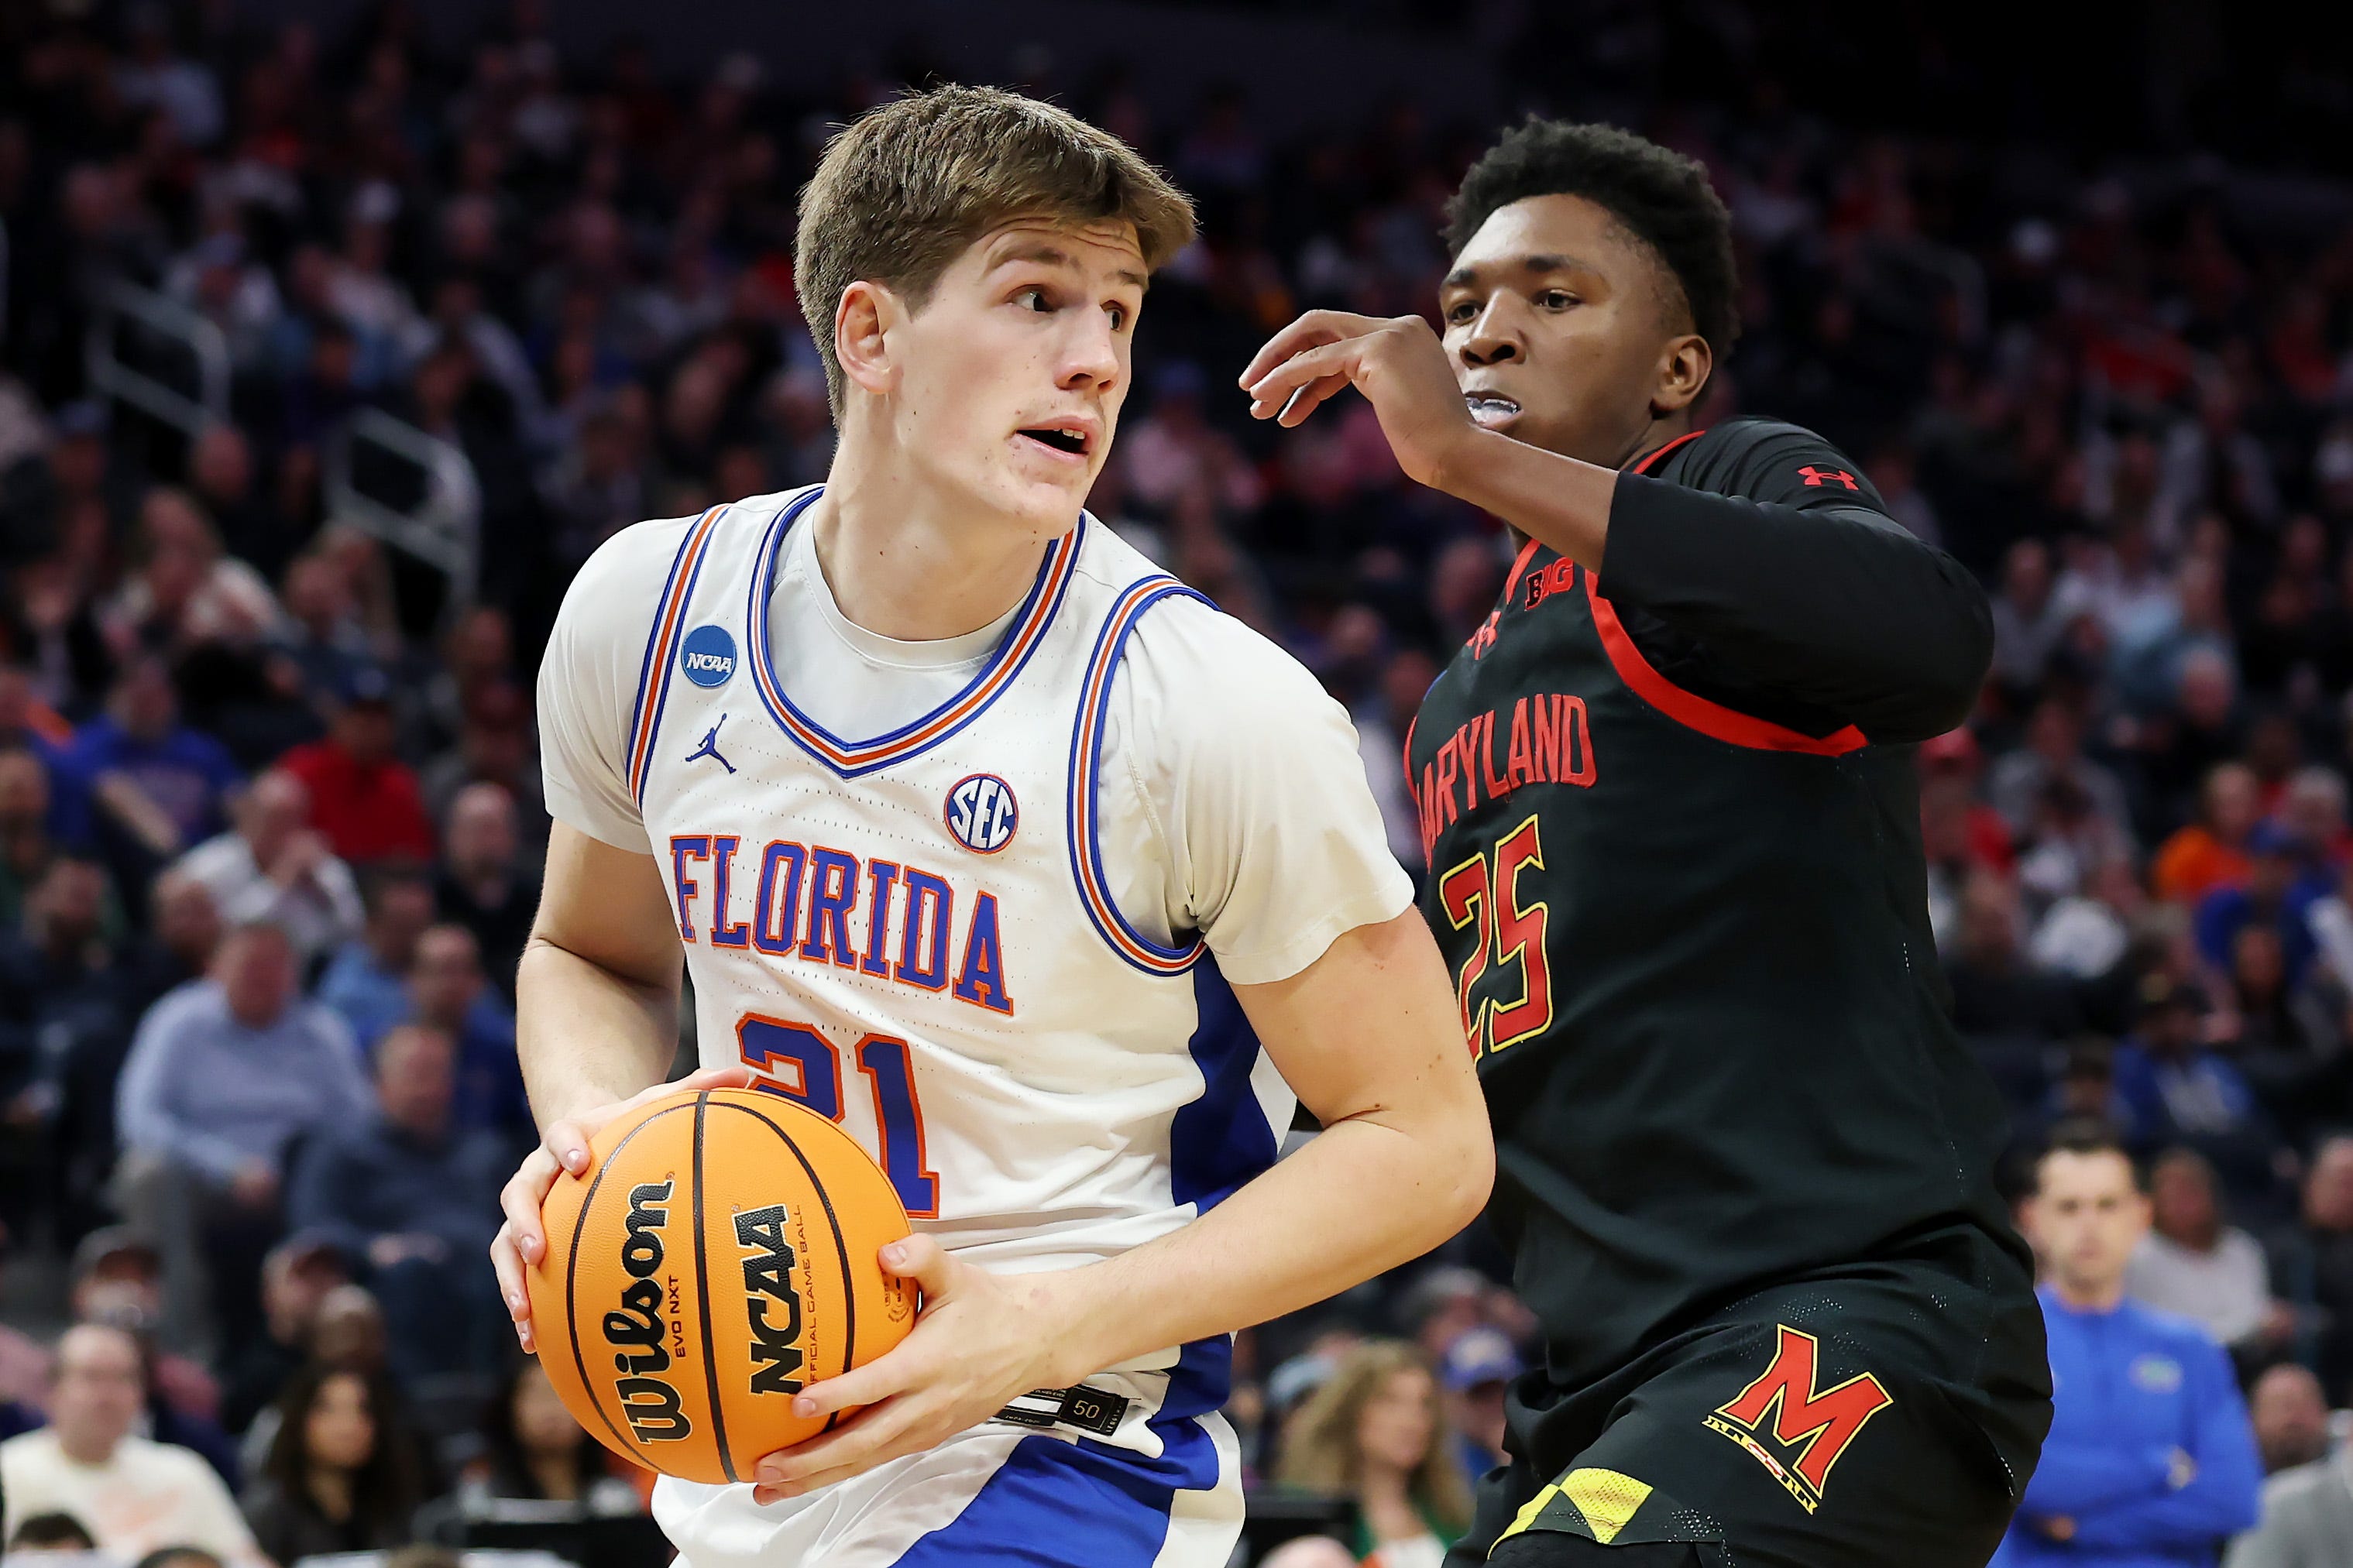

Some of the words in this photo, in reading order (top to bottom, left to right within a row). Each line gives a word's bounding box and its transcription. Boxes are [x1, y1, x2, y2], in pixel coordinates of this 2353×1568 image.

[686, 652, 733, 674] NCAA
[950, 777, 1014, 849] SEC
[669, 835, 1015, 1017] FLORIDA
[1438, 813, 1553, 1064] 25
[734, 1011, 939, 1220] 21
[793, 1204, 808, 1254] BALL
[603, 1179, 693, 1445] Wilson
[668, 1275, 681, 1313] NXT
[731, 1203, 803, 1397] NCAA
[802, 1258, 816, 1314] GAME
[673, 1320, 686, 1358] EVO
[808, 1316, 818, 1386] FFICIAL
[1073, 1399, 1101, 1419] 50
[1713, 1323, 1894, 1500] M
